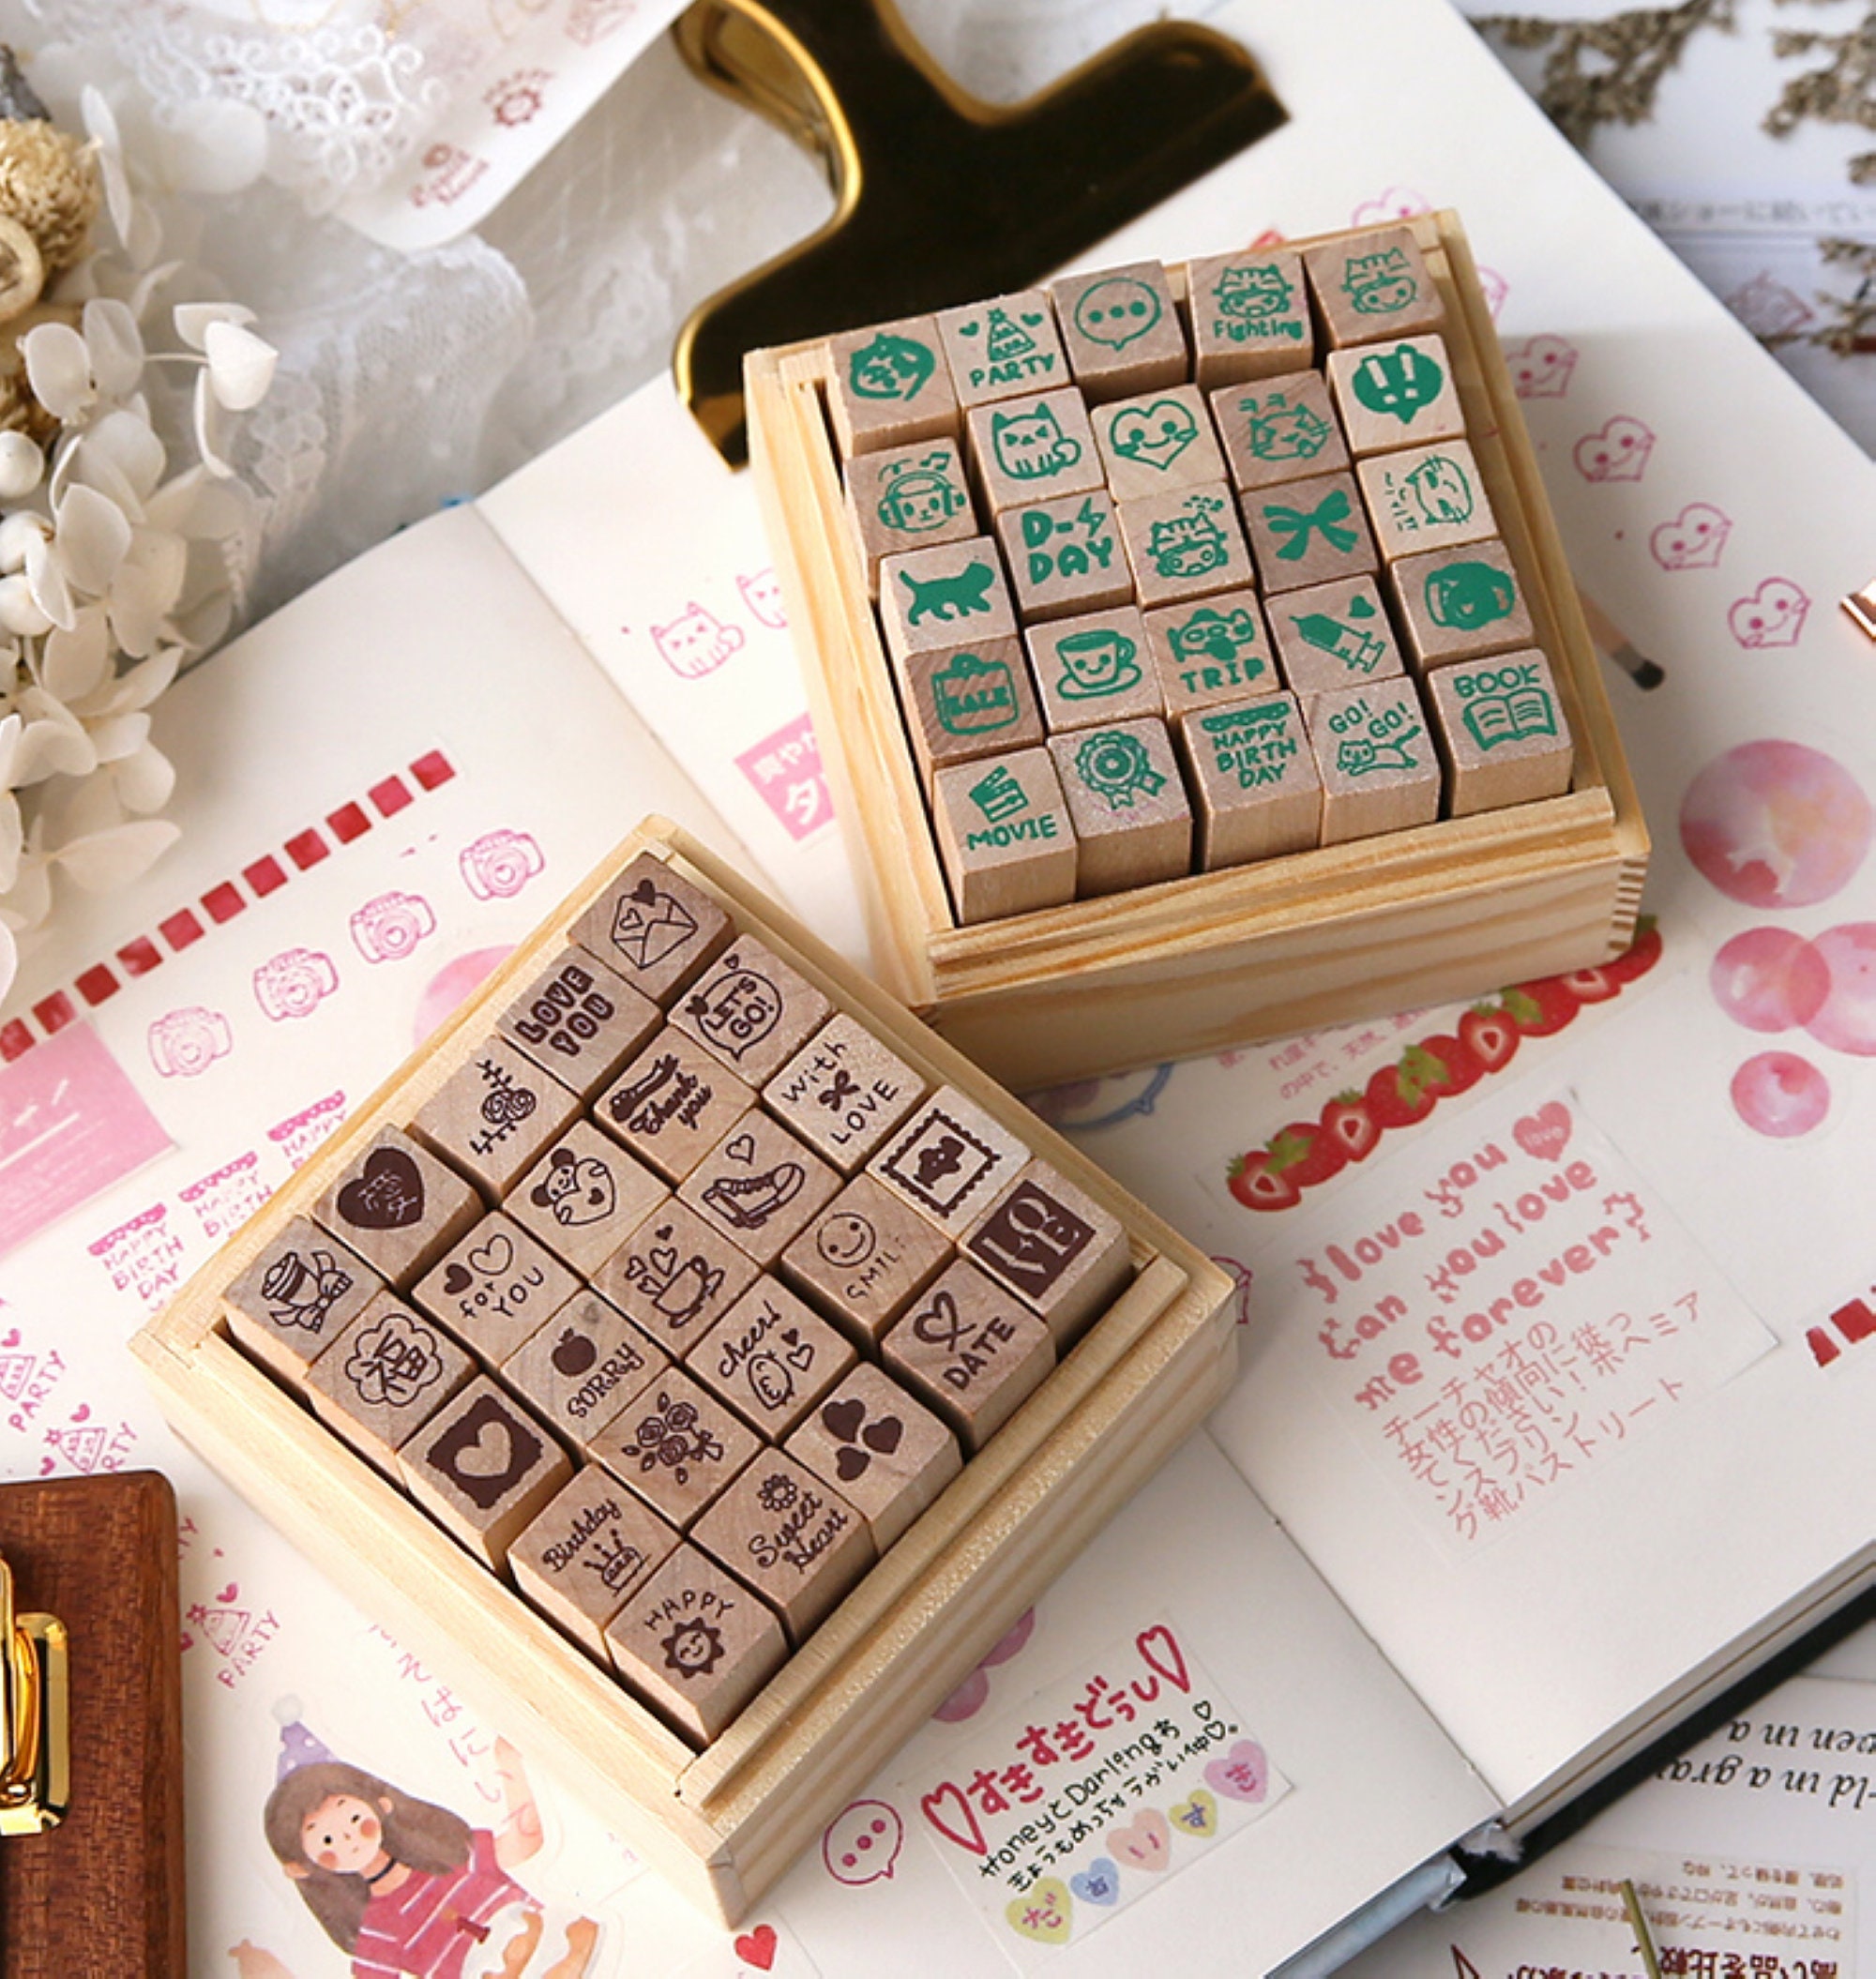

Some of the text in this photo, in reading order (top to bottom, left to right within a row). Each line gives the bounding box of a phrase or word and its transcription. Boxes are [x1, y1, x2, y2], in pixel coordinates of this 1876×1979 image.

[971, 354, 1055, 387] PARTY
[1029, 537, 1112, 584] DAY
[1180, 658, 1264, 693] TRIP
[1453, 664, 1540, 698] BOOK
[1213, 720, 1286, 750] HAPPY
[1328, 699, 1415, 738] GO! GO!
[1218, 738, 1296, 772] BIRTH
[1239, 764, 1286, 789] DAY
[967, 815, 1058, 851] MOVIE
[514, 965, 595, 1044] LOVE
[730, 996, 775, 1038] GO!
[678, 1085, 713, 1129] you
[830, 1080, 899, 1144] LOVE
[1424, 1142, 1508, 1217] you
[1492, 1160, 1597, 1234] love
[847, 1237, 908, 1299] SMIL
[492, 1266, 545, 1318] YOU
[943, 1316, 1016, 1391] DATE
[8, 1350, 66, 1433] PARTY
[101, 1421, 138, 1472] RTY
[643, 1589, 734, 1630] HAPPY
[217, 1609, 280, 1688] PARTY
[1728, 1721, 1750, 1744] a
[1764, 1725, 1799, 1749] in
[1747, 1767, 1771, 1790] a
[1784, 1772, 1821, 1795] in
